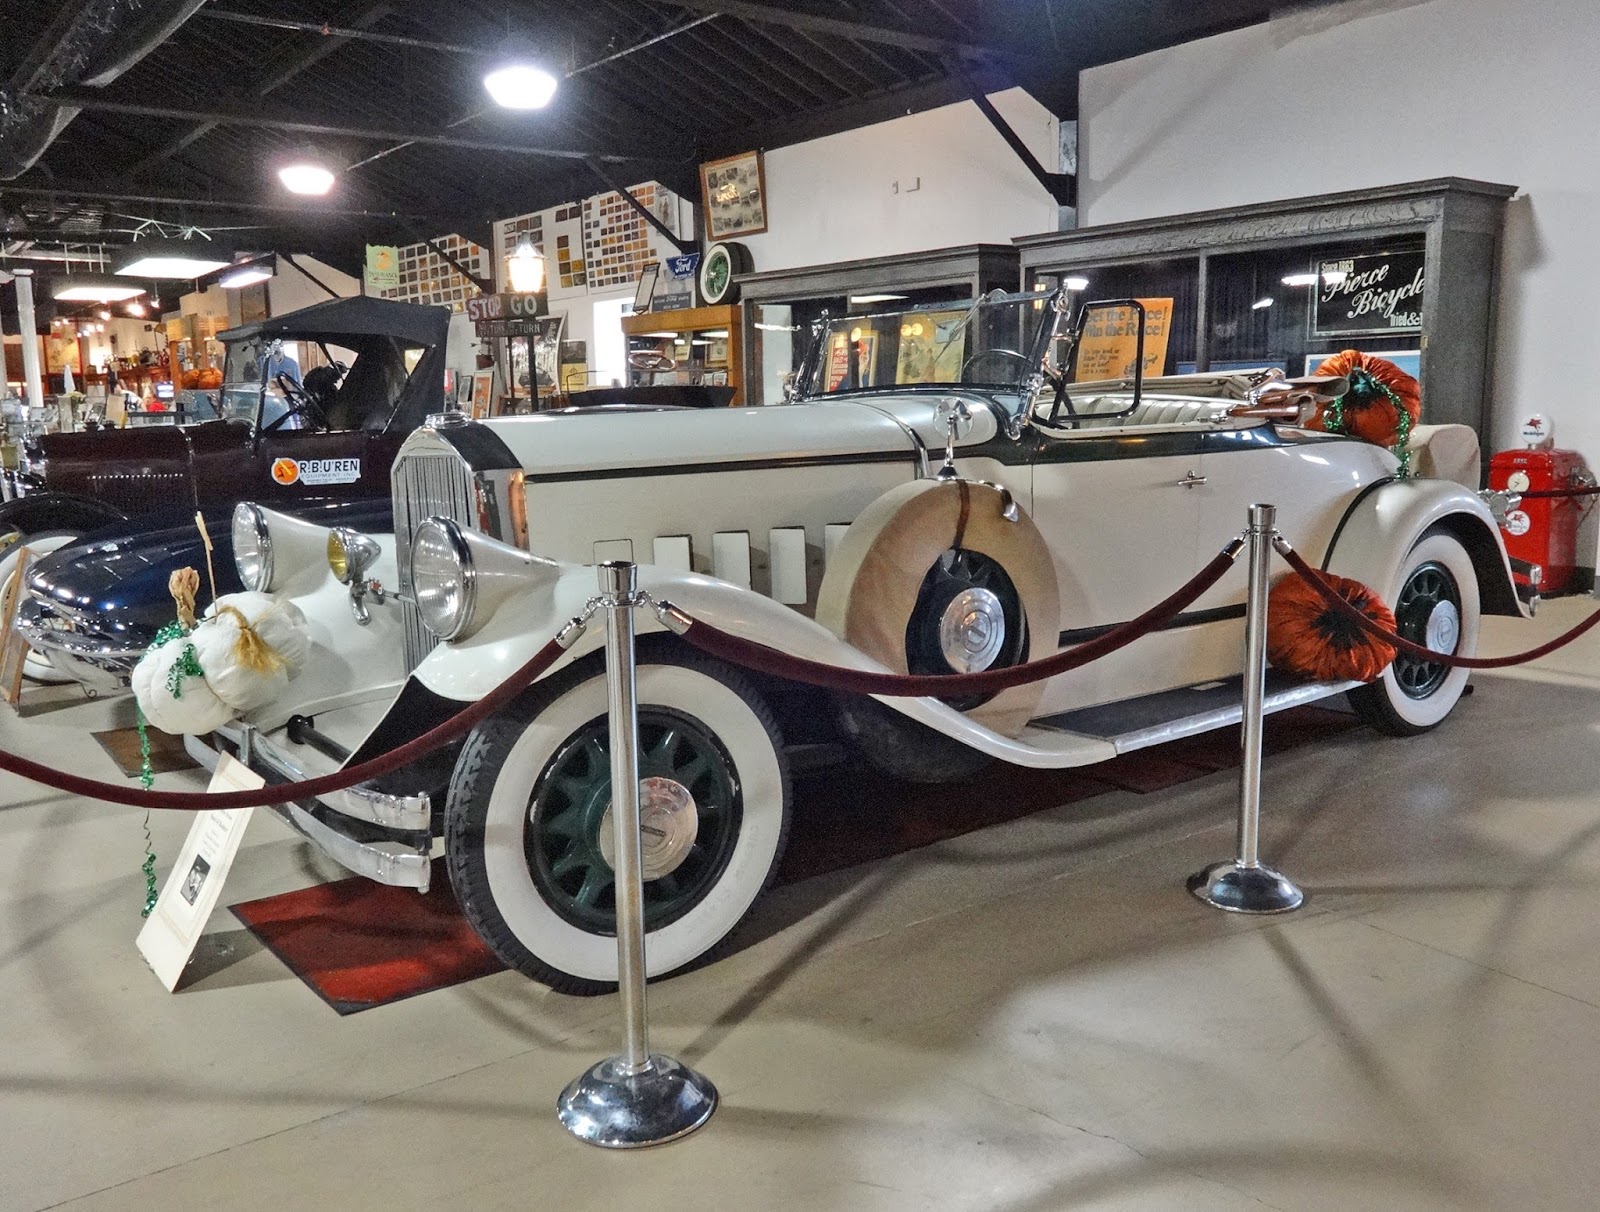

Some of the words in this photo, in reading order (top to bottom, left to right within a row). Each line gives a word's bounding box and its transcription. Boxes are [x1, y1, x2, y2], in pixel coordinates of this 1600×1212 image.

[675, 257, 691, 273] Ford
[1321, 264, 1389, 302] Pierce
[468, 295, 501, 320] STOP
[510, 294, 537, 315] GO
[1107, 308, 1125, 321] the
[1130, 306, 1168, 320] Pce!
[1390, 312, 1407, 326] Tried
[1105, 322, 1124, 336] the
[1125, 322, 1165, 336] Rce!
